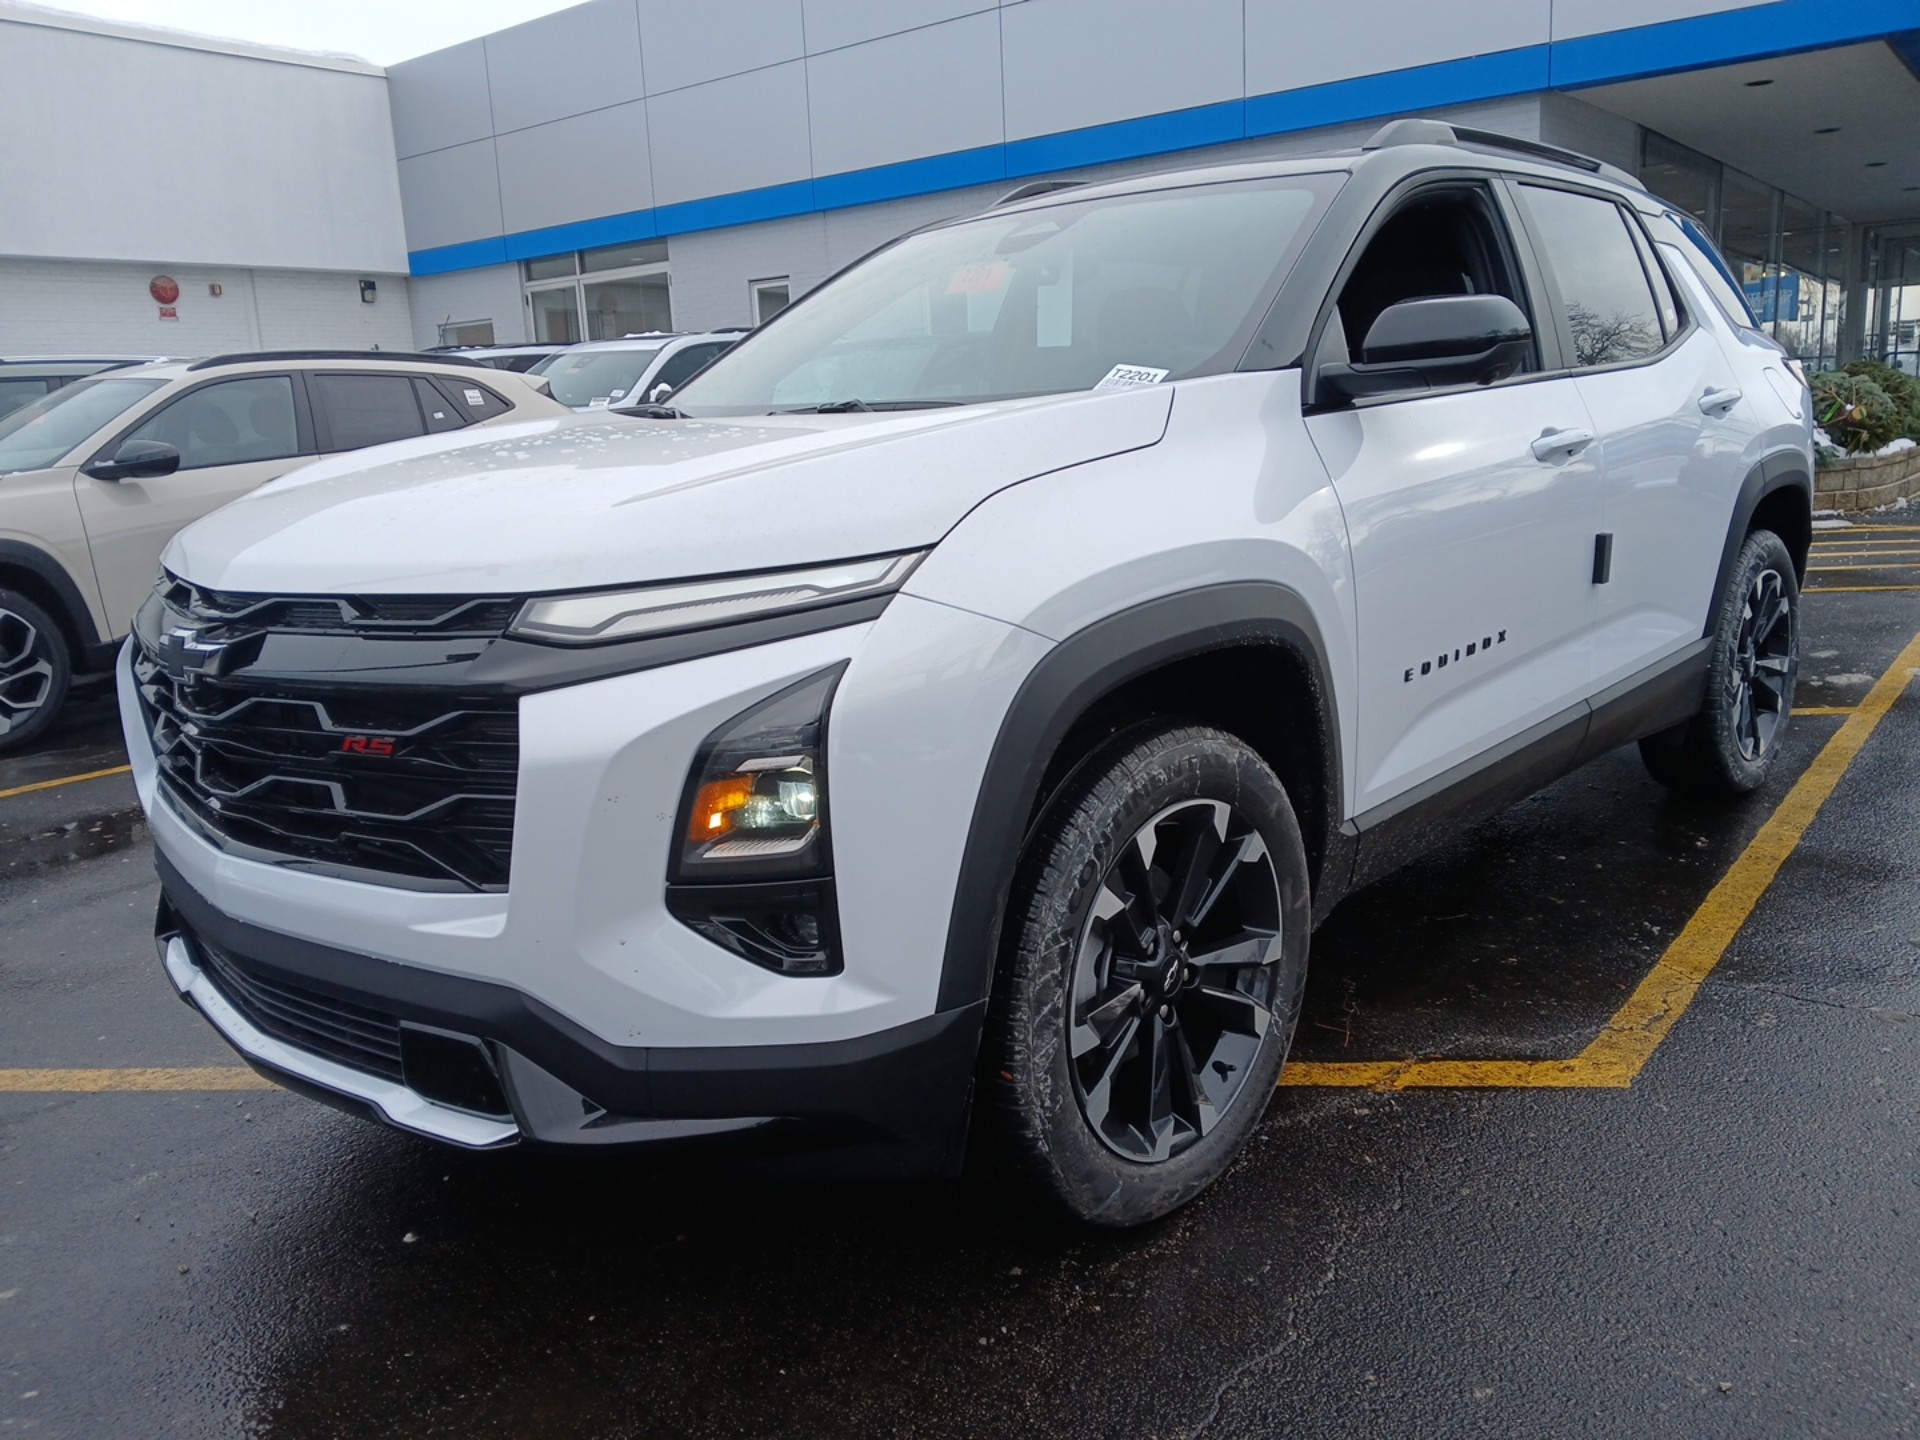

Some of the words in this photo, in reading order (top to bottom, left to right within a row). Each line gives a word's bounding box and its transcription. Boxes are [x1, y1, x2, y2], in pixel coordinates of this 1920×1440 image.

[1111, 368, 1159, 383] T2201
[1403, 629, 1507, 683] EQUINOX
[342, 736, 396, 756] RS
